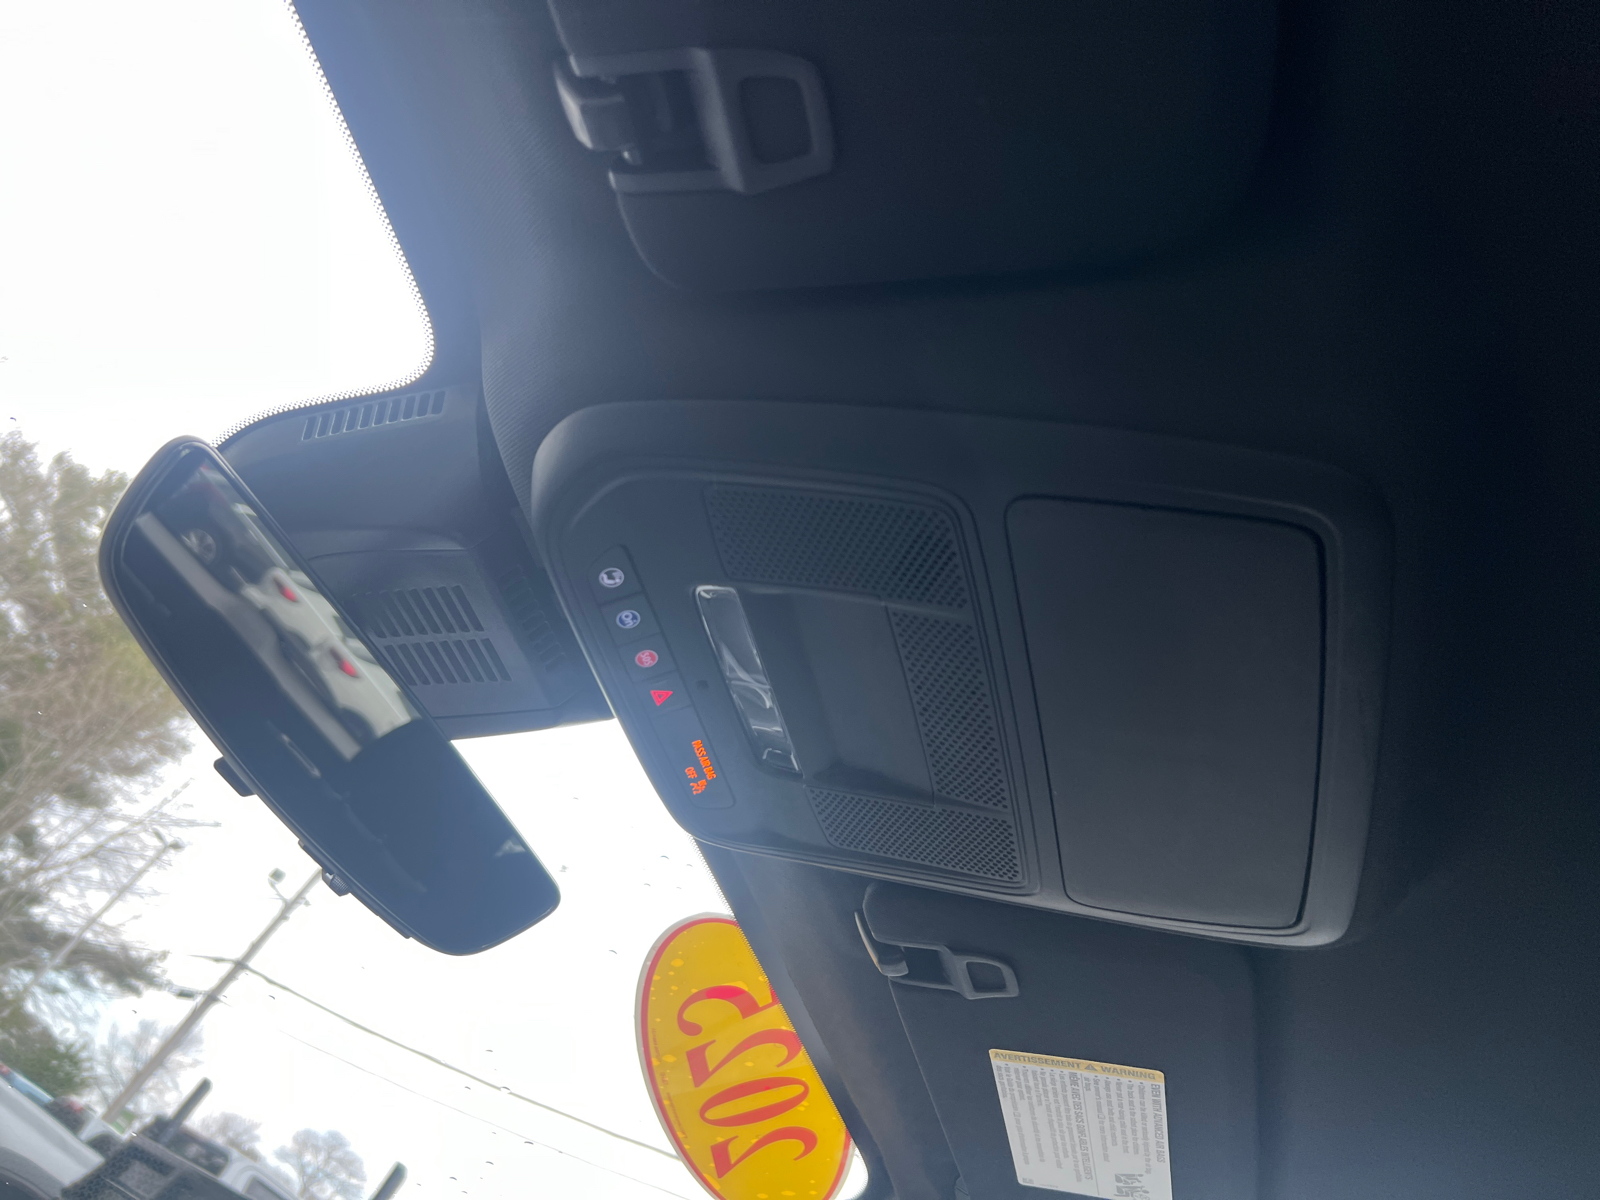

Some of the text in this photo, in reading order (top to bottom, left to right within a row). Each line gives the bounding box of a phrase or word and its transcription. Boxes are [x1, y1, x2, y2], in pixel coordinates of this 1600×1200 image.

[640, 652, 654, 667] SOS
[692, 740, 716, 780] PASS AIR BAG
[685, 766, 698, 779] OFF
[994, 1052, 1156, 1080] AVERTISSEMENT WARNING
